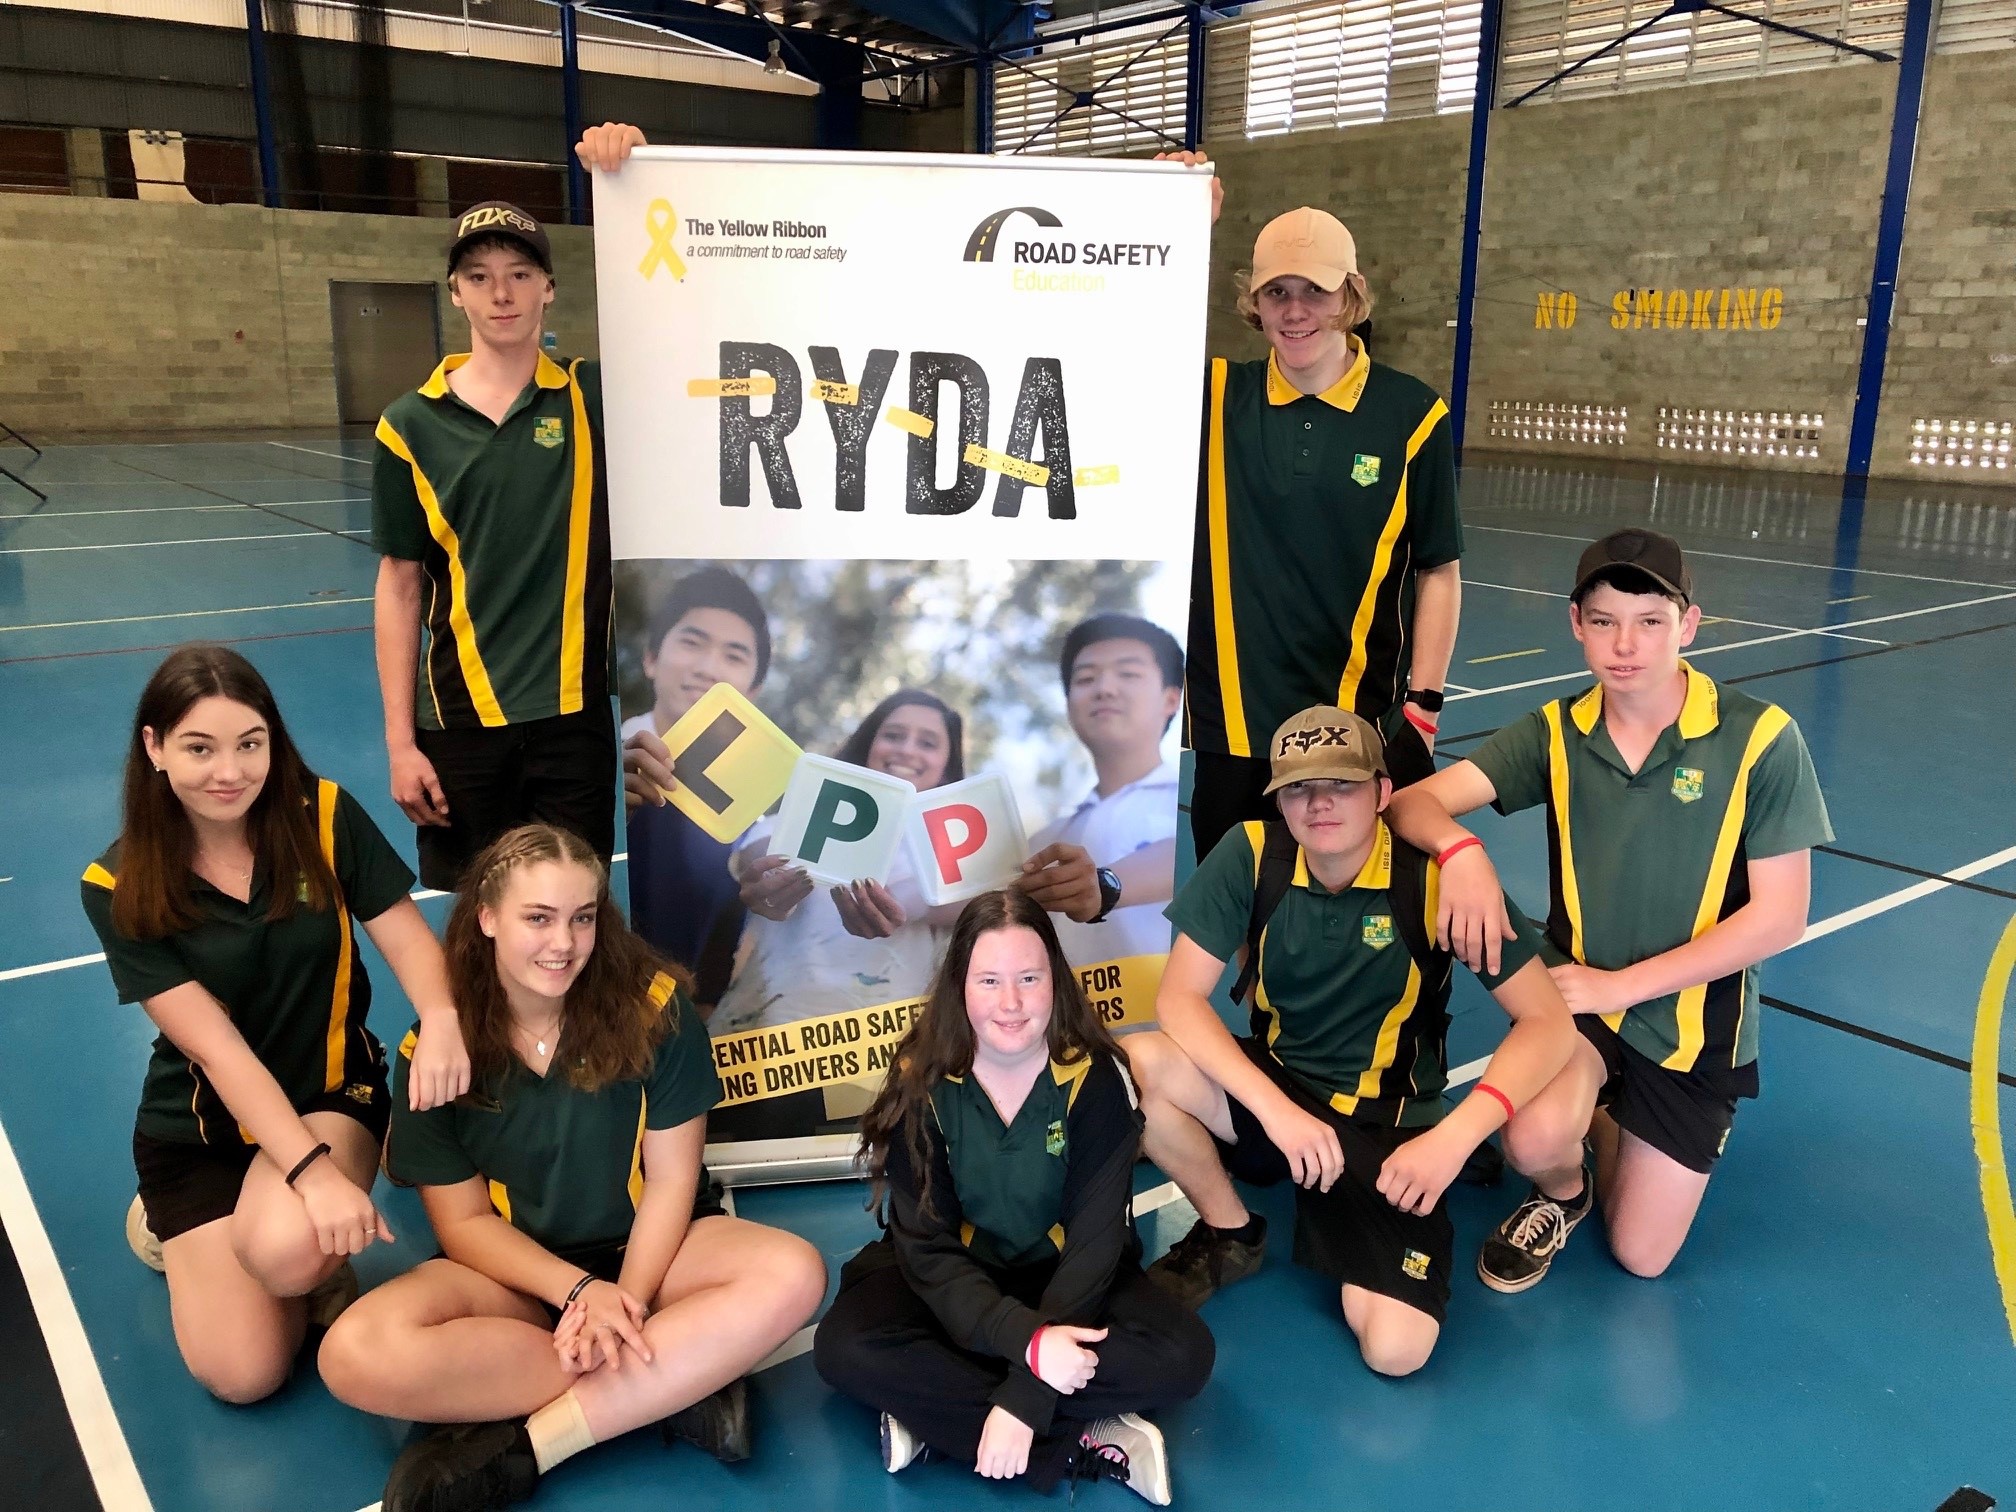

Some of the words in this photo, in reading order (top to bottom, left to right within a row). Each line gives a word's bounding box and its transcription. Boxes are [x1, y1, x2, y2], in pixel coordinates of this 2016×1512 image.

[458, 207, 512, 238] FOX
[685, 218, 715, 236] The
[718, 219, 768, 237] Yellow
[773, 220, 827, 238] Ribbon
[686, 245, 694, 257] a
[697, 244, 769, 259] commitment
[772, 245, 782, 259] to
[785, 245, 811, 259] road
[813, 245, 847, 263] safety
[1014, 241, 1076, 264] ROAD
[1082, 243, 1171, 266] SAFETY
[1013, 269, 1105, 293] Education
[1535, 290, 1578, 330] NO
[1610, 288, 1783, 331] SMOKING
[719, 340, 1077, 520] RYDA
[674, 708, 747, 816] L
[796, 777, 880, 864] P
[922, 802, 988, 885] P
[711, 1030, 796, 1069] ENTIAL
[800, 1017, 861, 1052] ROAD
[1080, 965, 1122, 995] FOR
[763, 1050, 860, 1093] DRIVERS
[867, 1040, 900, 1072] AN
[1089, 996, 1125, 1023] RS
